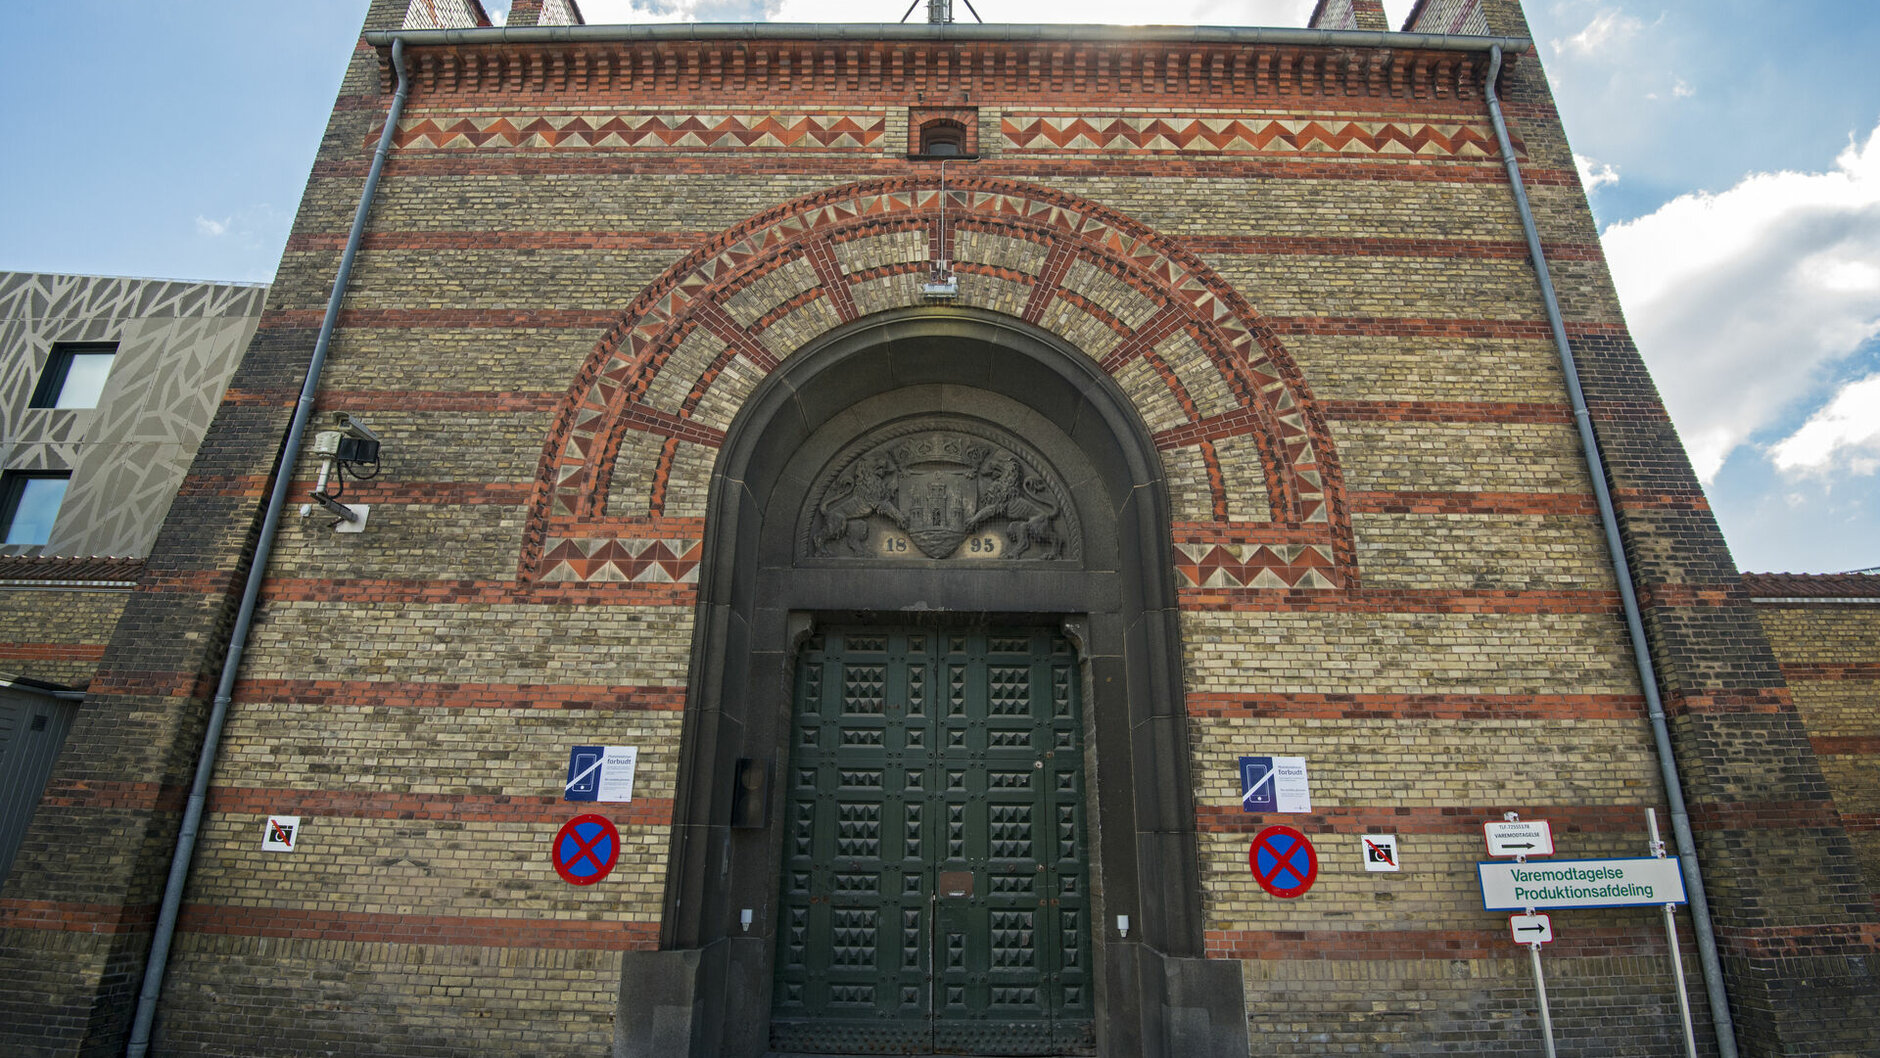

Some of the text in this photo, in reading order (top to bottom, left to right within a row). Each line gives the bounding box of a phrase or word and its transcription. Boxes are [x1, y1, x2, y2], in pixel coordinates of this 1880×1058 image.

[886, 538, 994, 552] 18 95
[1510, 866, 1624, 882] Varemodtagelse
[1514, 884, 1654, 900] Produktionsafdeling
